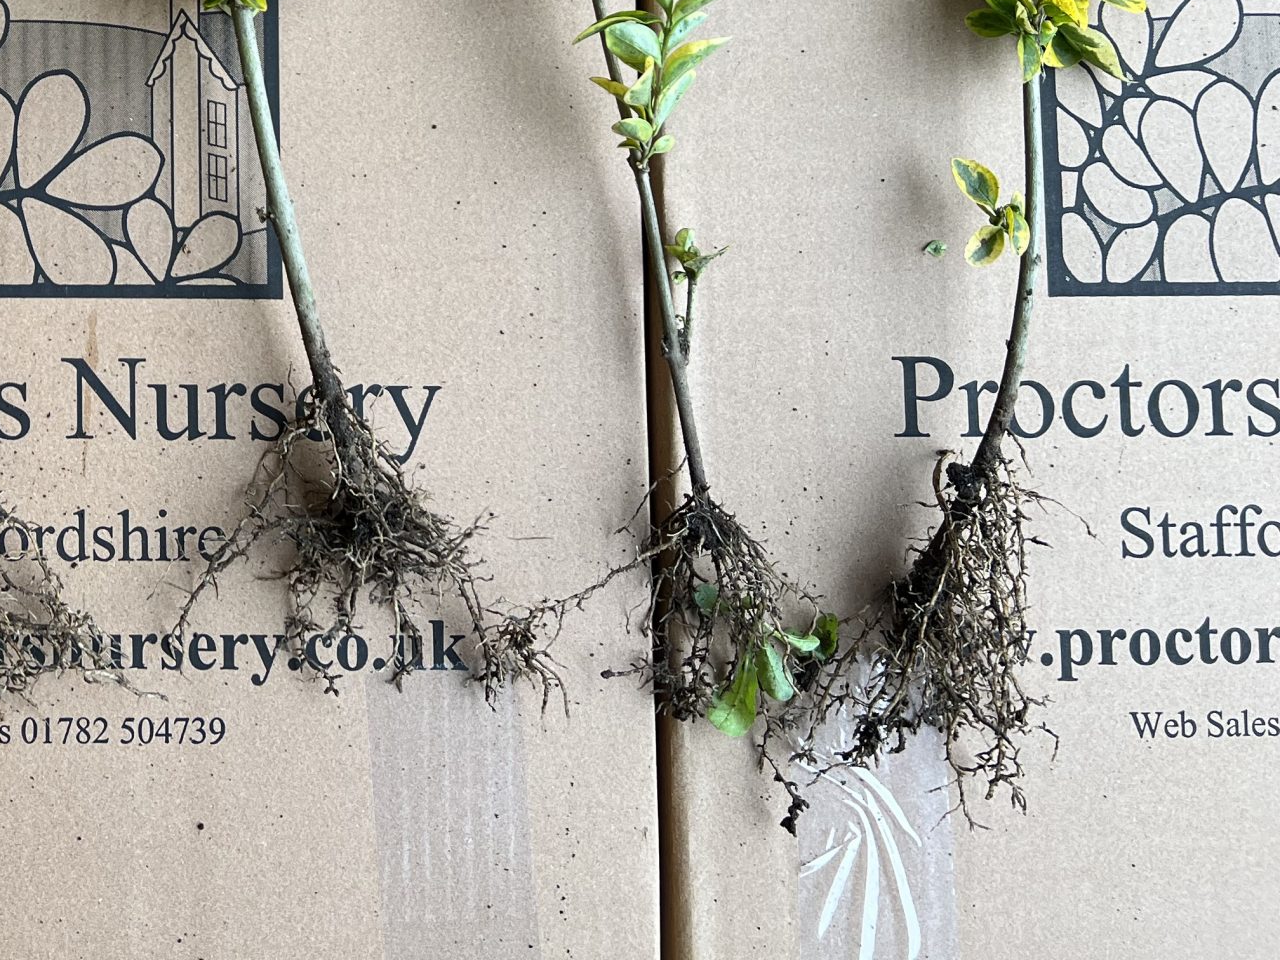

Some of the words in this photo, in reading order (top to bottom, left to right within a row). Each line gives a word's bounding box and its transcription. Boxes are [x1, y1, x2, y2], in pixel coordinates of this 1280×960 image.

[21, 717, 109, 745] 01782
[121, 717, 226, 746] 504739
[1129, 710, 1198, 739] Web
[1206, 709, 1280, 738] Sales
